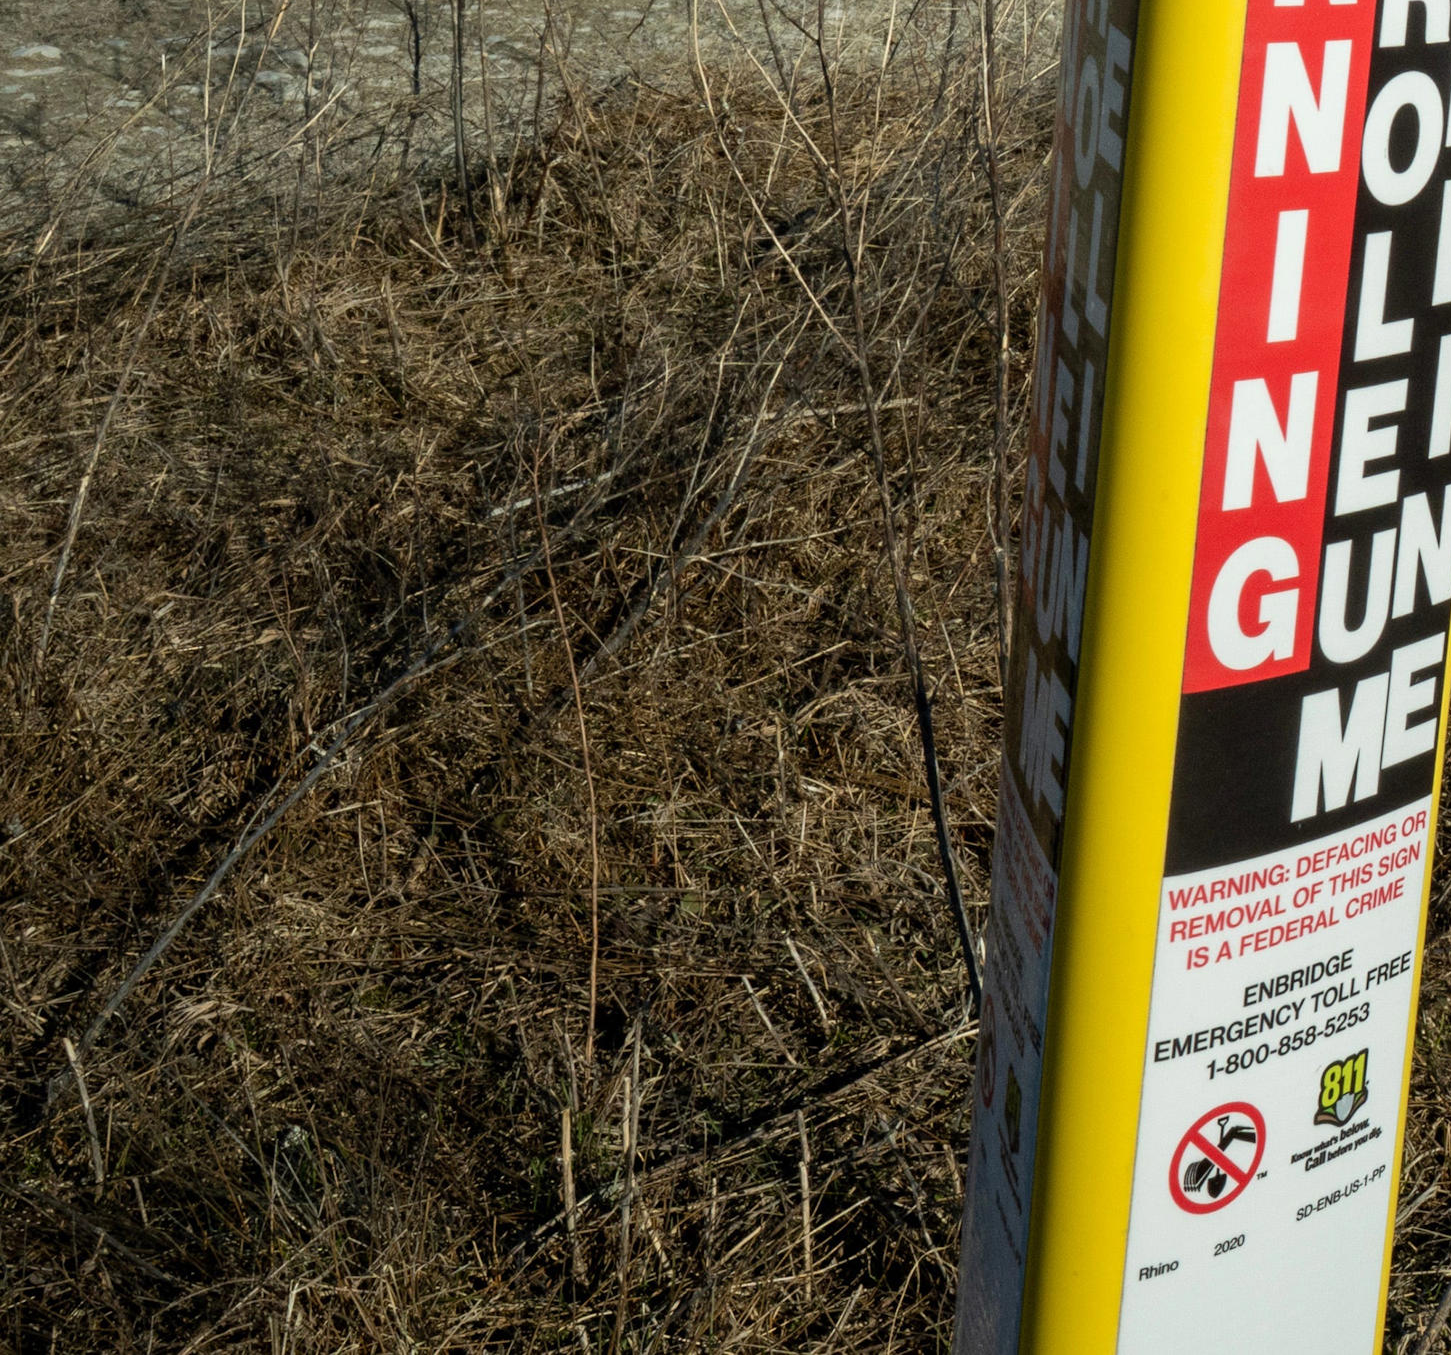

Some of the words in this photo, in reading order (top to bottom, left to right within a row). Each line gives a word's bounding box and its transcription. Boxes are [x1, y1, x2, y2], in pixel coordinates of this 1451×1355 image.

[1168, 864, 1291, 910] WARNING:
[1296, 824, 1397, 878] DEFACING
[1401, 810, 1427, 838] OR
[1169, 895, 1286, 943] REMOVAL
[1292, 881, 1323, 909] OF
[1329, 862, 1373, 896] THIS
[1379, 841, 1421, 874] SIGN
[1186, 946, 1209, 970] IS
[1215, 941, 1232, 963] A
[1239, 906, 1340, 956] FEDERAL
[1345, 876, 1406, 920] CRIME
[1153, 999, 1306, 1063] EMERGENCY
[1311, 978, 1361, 1013] TOLL
[1365, 951, 1413, 991] FREE
[1243, 948, 1354, 1007] ENBRIDGE
[1207, 1002, 1371, 1080] 1-800-858-5253
[1320, 1049, 1367, 1110] 811
[1291, 1148, 1314, 1164] Know
[1305, 1150, 1327, 1172] Call
[1327, 1142, 1353, 1161] before
[1354, 1134, 1368, 1150] you
[1296, 1164, 1386, 1221] SD-ENB-US-1-PP
[1138, 1260, 1179, 1281] Rhino
[1213, 1234, 1246, 1257] 2020
